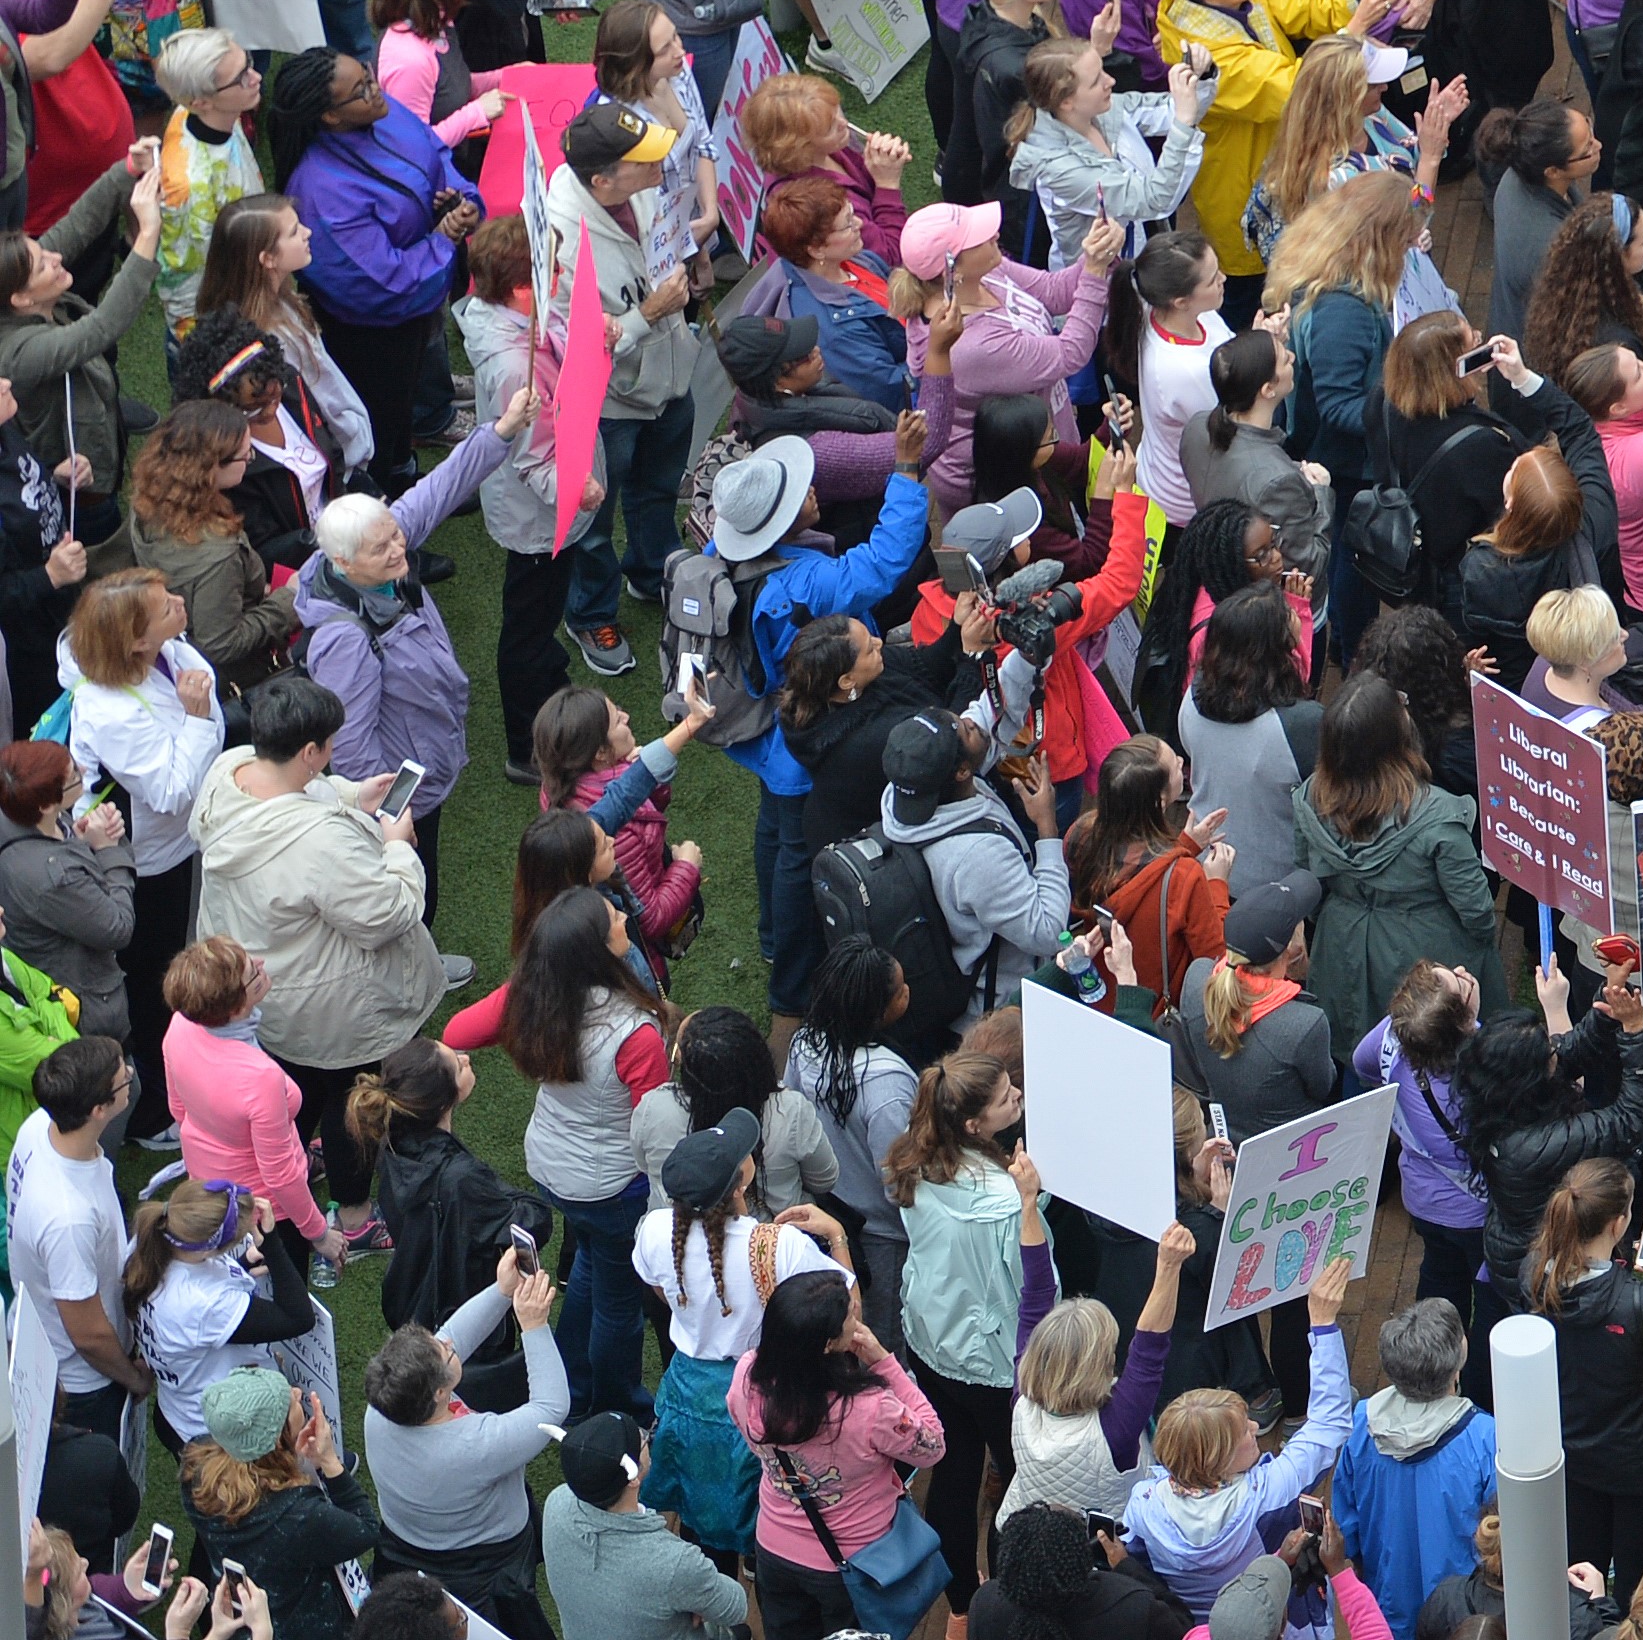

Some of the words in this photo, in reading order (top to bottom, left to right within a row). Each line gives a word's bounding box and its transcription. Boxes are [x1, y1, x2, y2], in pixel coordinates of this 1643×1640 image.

[1508, 722, 1569, 772] Liberal
[1499, 753, 1583, 815] Librarian:
[1508, 795, 1577, 847] Because
[1486, 815, 1493, 831] I
[1497, 822, 1533, 860] Care
[1534, 850, 1546, 868] &
[1561, 859, 1605, 897] Read
[1278, 1122, 1339, 1181] I
[1229, 1176, 1369, 1245] Choose
[1223, 1202, 1369, 1312] LOVE
